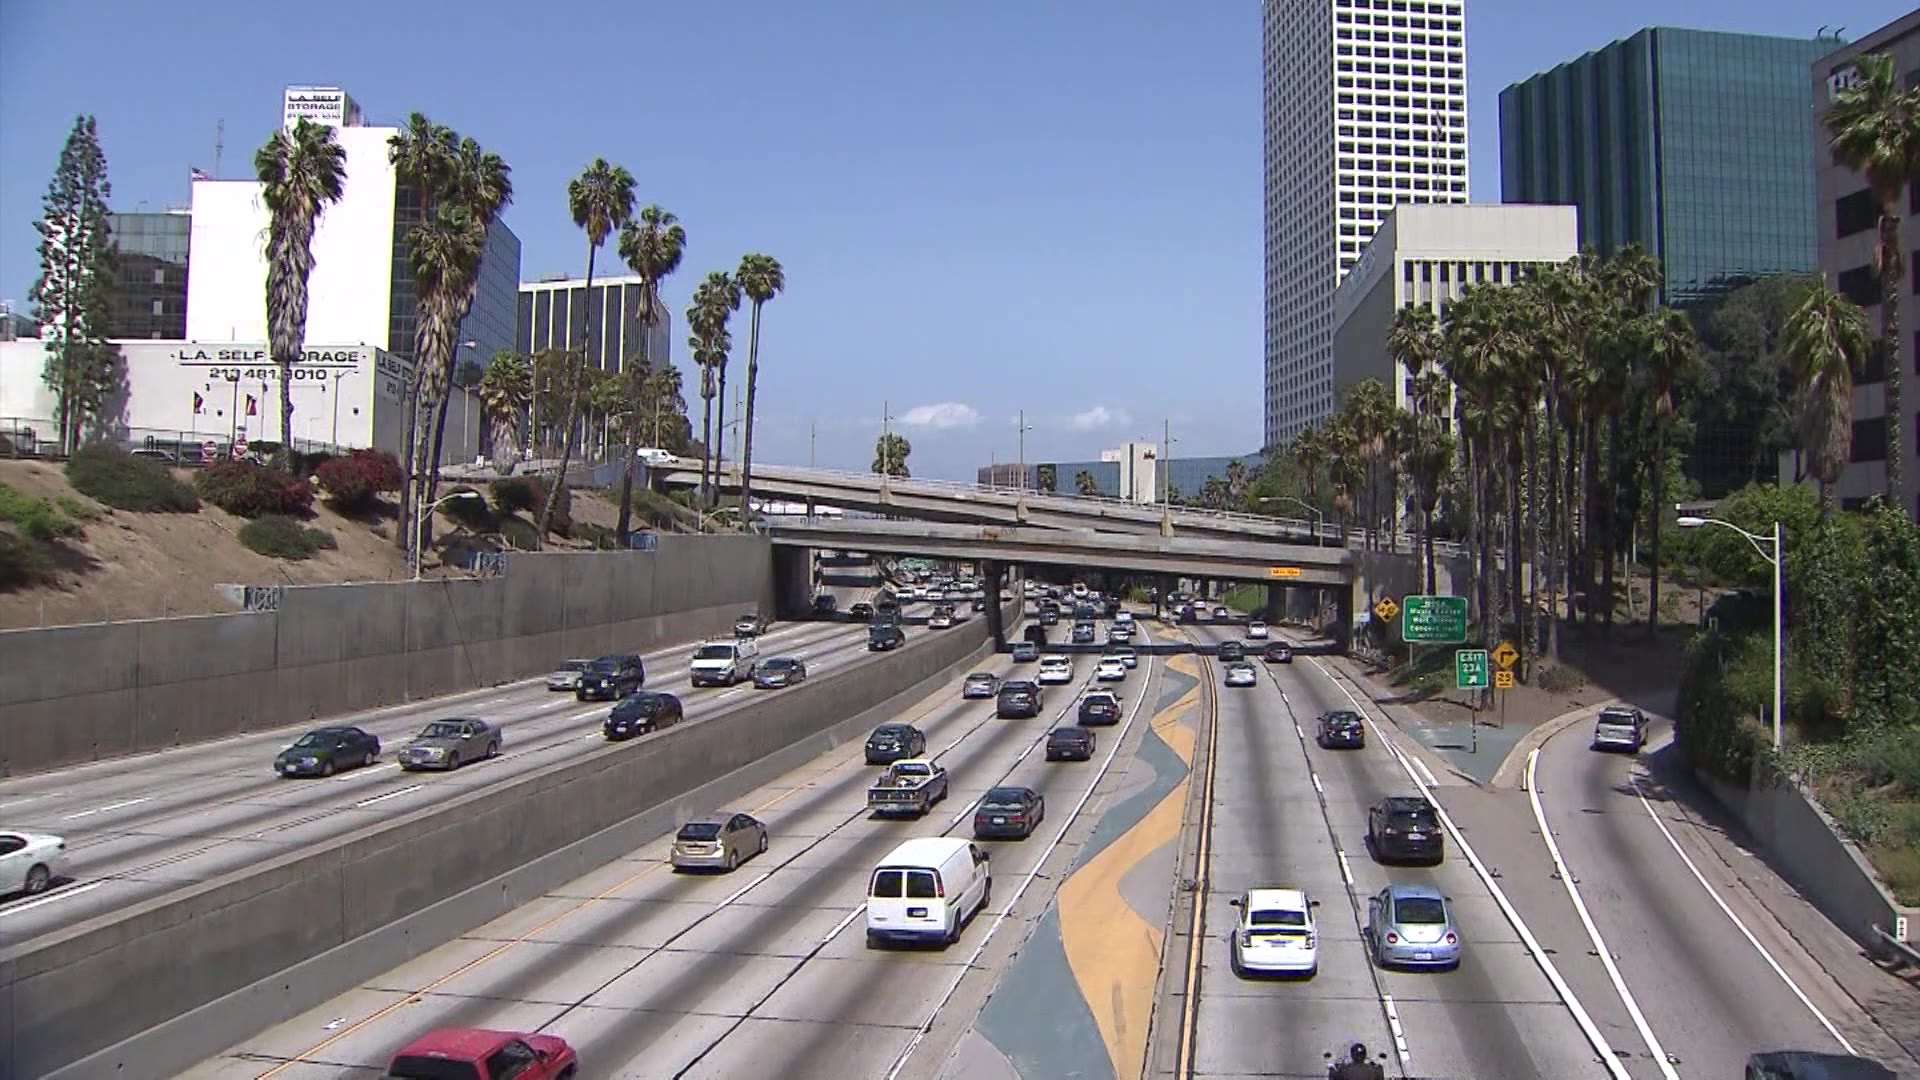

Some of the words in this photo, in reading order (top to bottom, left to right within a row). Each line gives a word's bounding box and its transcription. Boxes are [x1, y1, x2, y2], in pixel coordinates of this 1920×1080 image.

[179, 350, 212, 360] L.A.
[218, 350, 265, 361] SELF
[1460, 652, 1483, 662] EXIT
